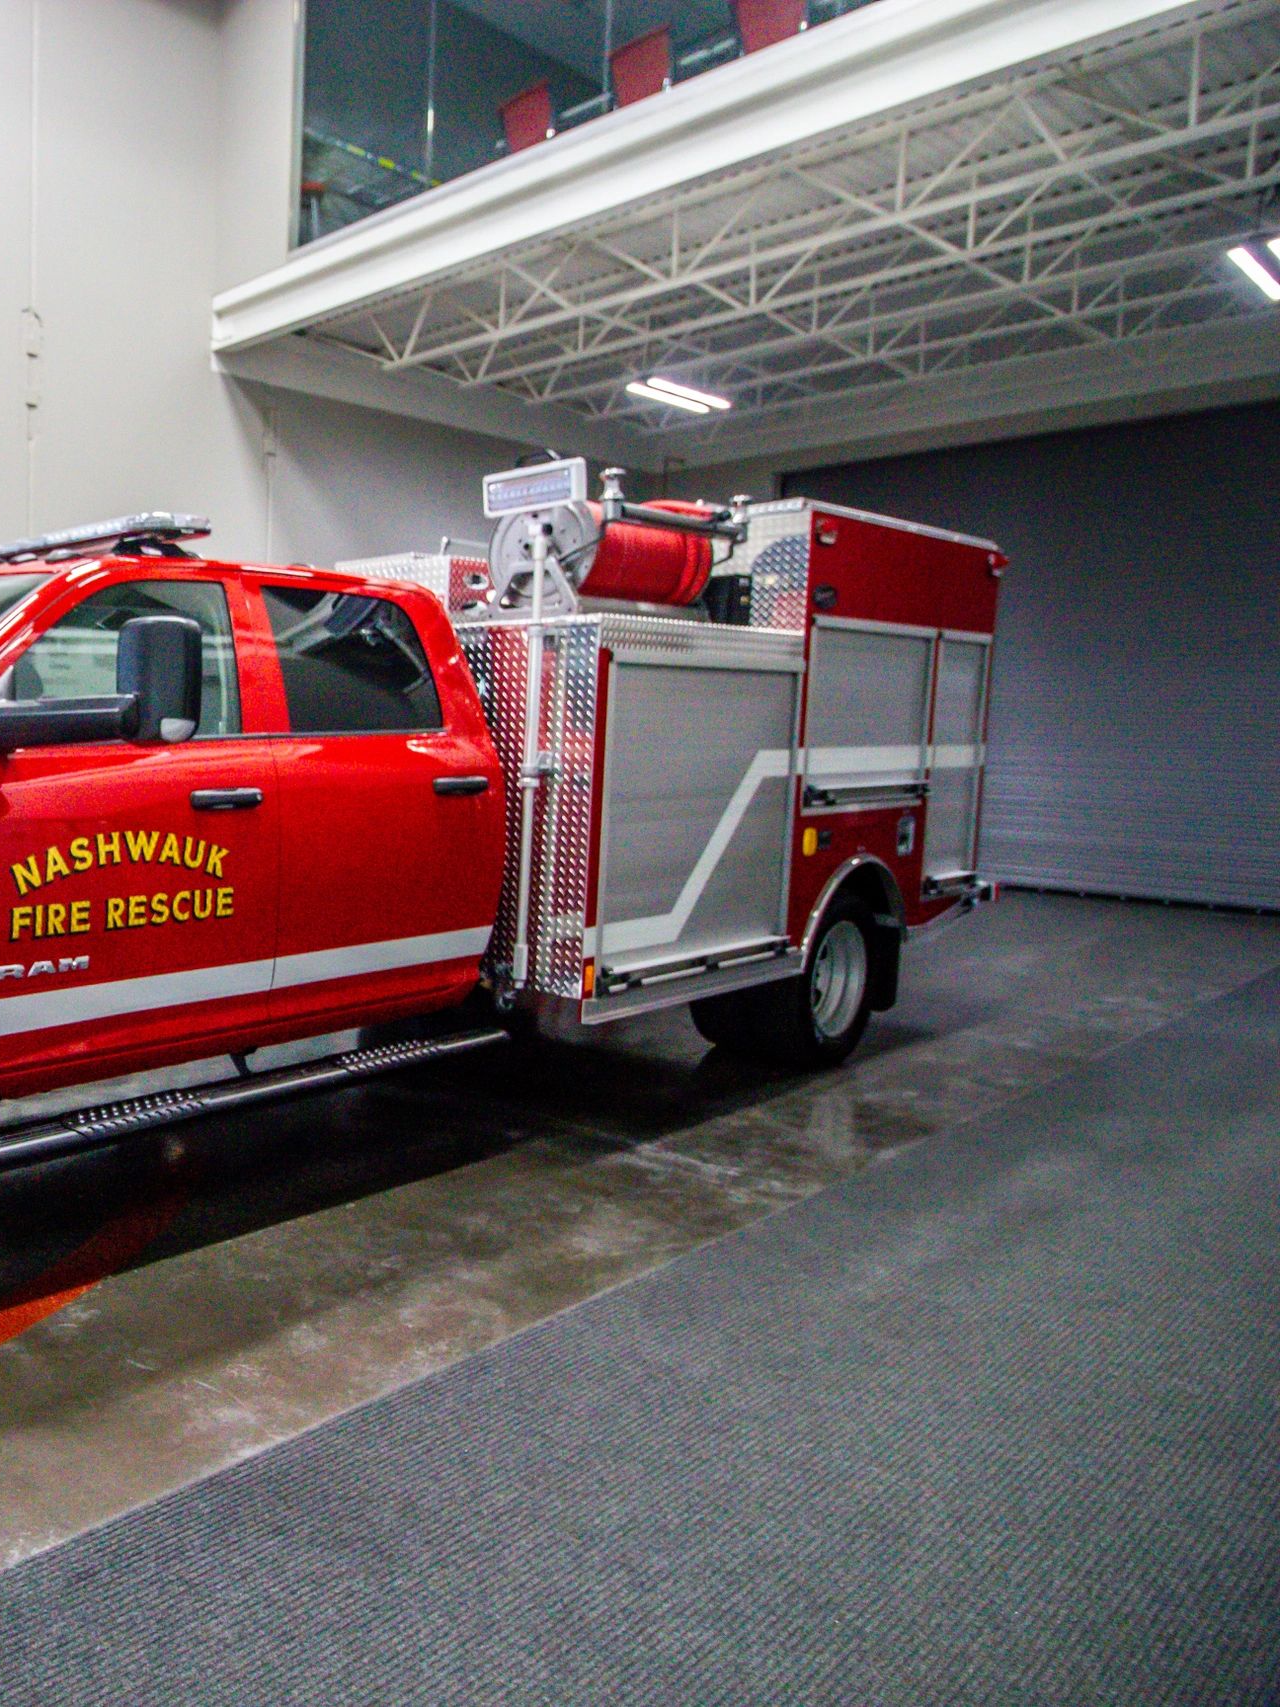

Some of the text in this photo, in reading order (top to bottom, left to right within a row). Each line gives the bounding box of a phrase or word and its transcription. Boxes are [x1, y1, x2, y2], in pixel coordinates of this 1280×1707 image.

[9, 829, 230, 895] NASHWAUK
[9, 886, 234, 941] FIRE RESCUE
